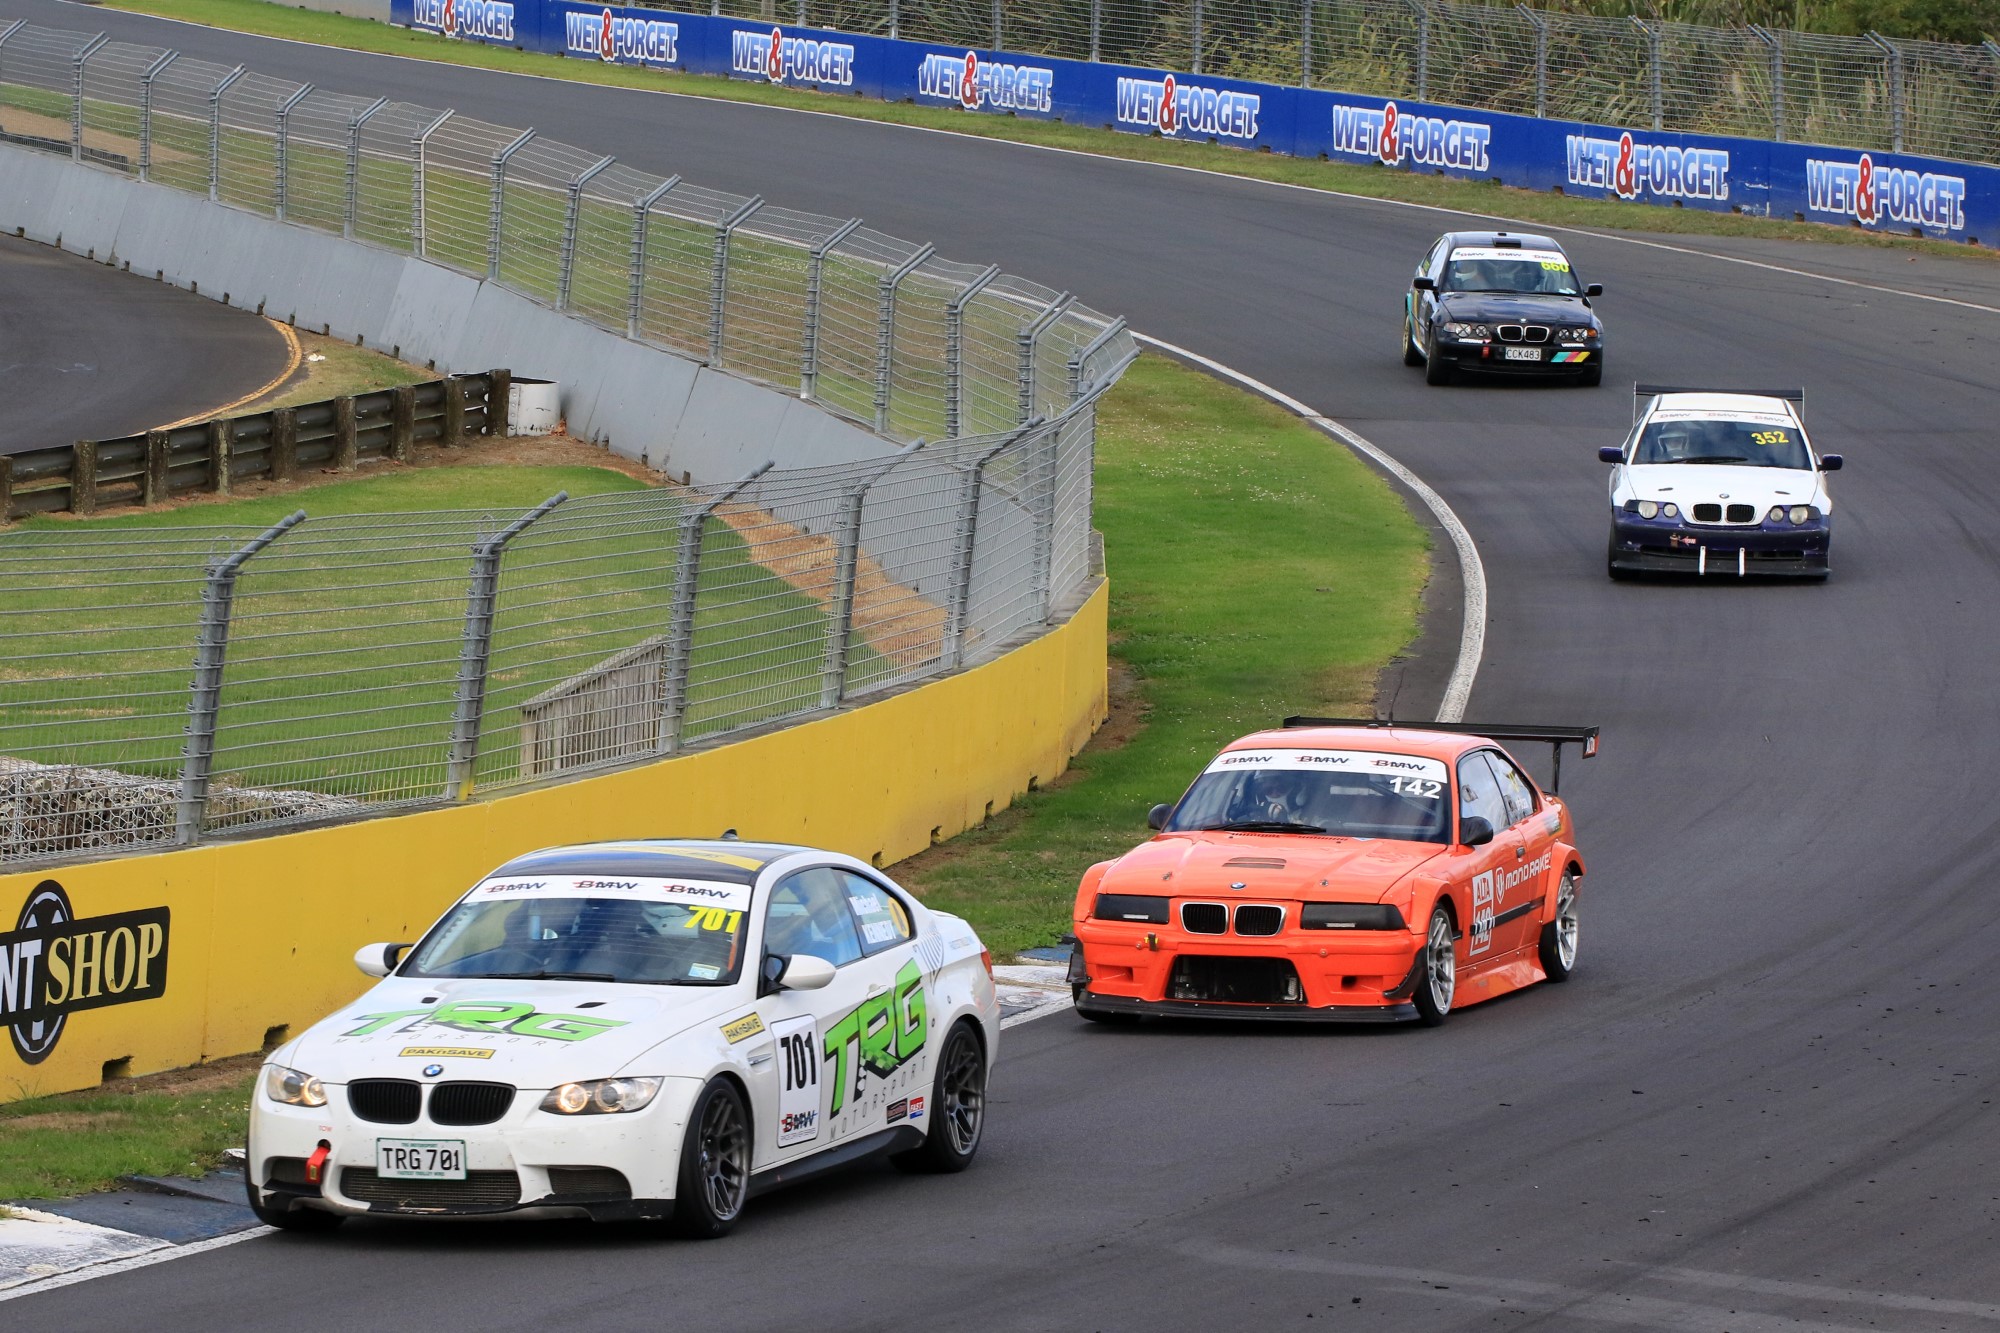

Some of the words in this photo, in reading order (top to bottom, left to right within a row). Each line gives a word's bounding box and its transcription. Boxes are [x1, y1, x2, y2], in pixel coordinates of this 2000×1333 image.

[1541, 261, 1569, 273] 660
[1505, 348, 1540, 360] CCK483
[1750, 430, 1789, 446] 352
[1221, 755, 1273, 765] BMW
[1294, 755, 1350, 765] BMW
[1370, 759, 1427, 772] BMW
[1389, 776, 1442, 800] 142
[485, 881, 548, 894] BMW
[572, 880, 639, 890] BMW
[663, 884, 731, 899] BMW
[684, 905, 743, 934] 701
[45, 922, 164, 1006] SHOP
[340, 1000, 632, 1042] TRG
[333, 1033, 571, 1050] MOTORSPORT
[824, 957, 927, 1120] TRG
[780, 1031, 817, 1092] 701
[829, 1055, 927, 1140] MOTORSPORT
[781, 1110, 817, 1133] BMW
[382, 1147, 421, 1170] TRG
[426, 1149, 460, 1171] 701
